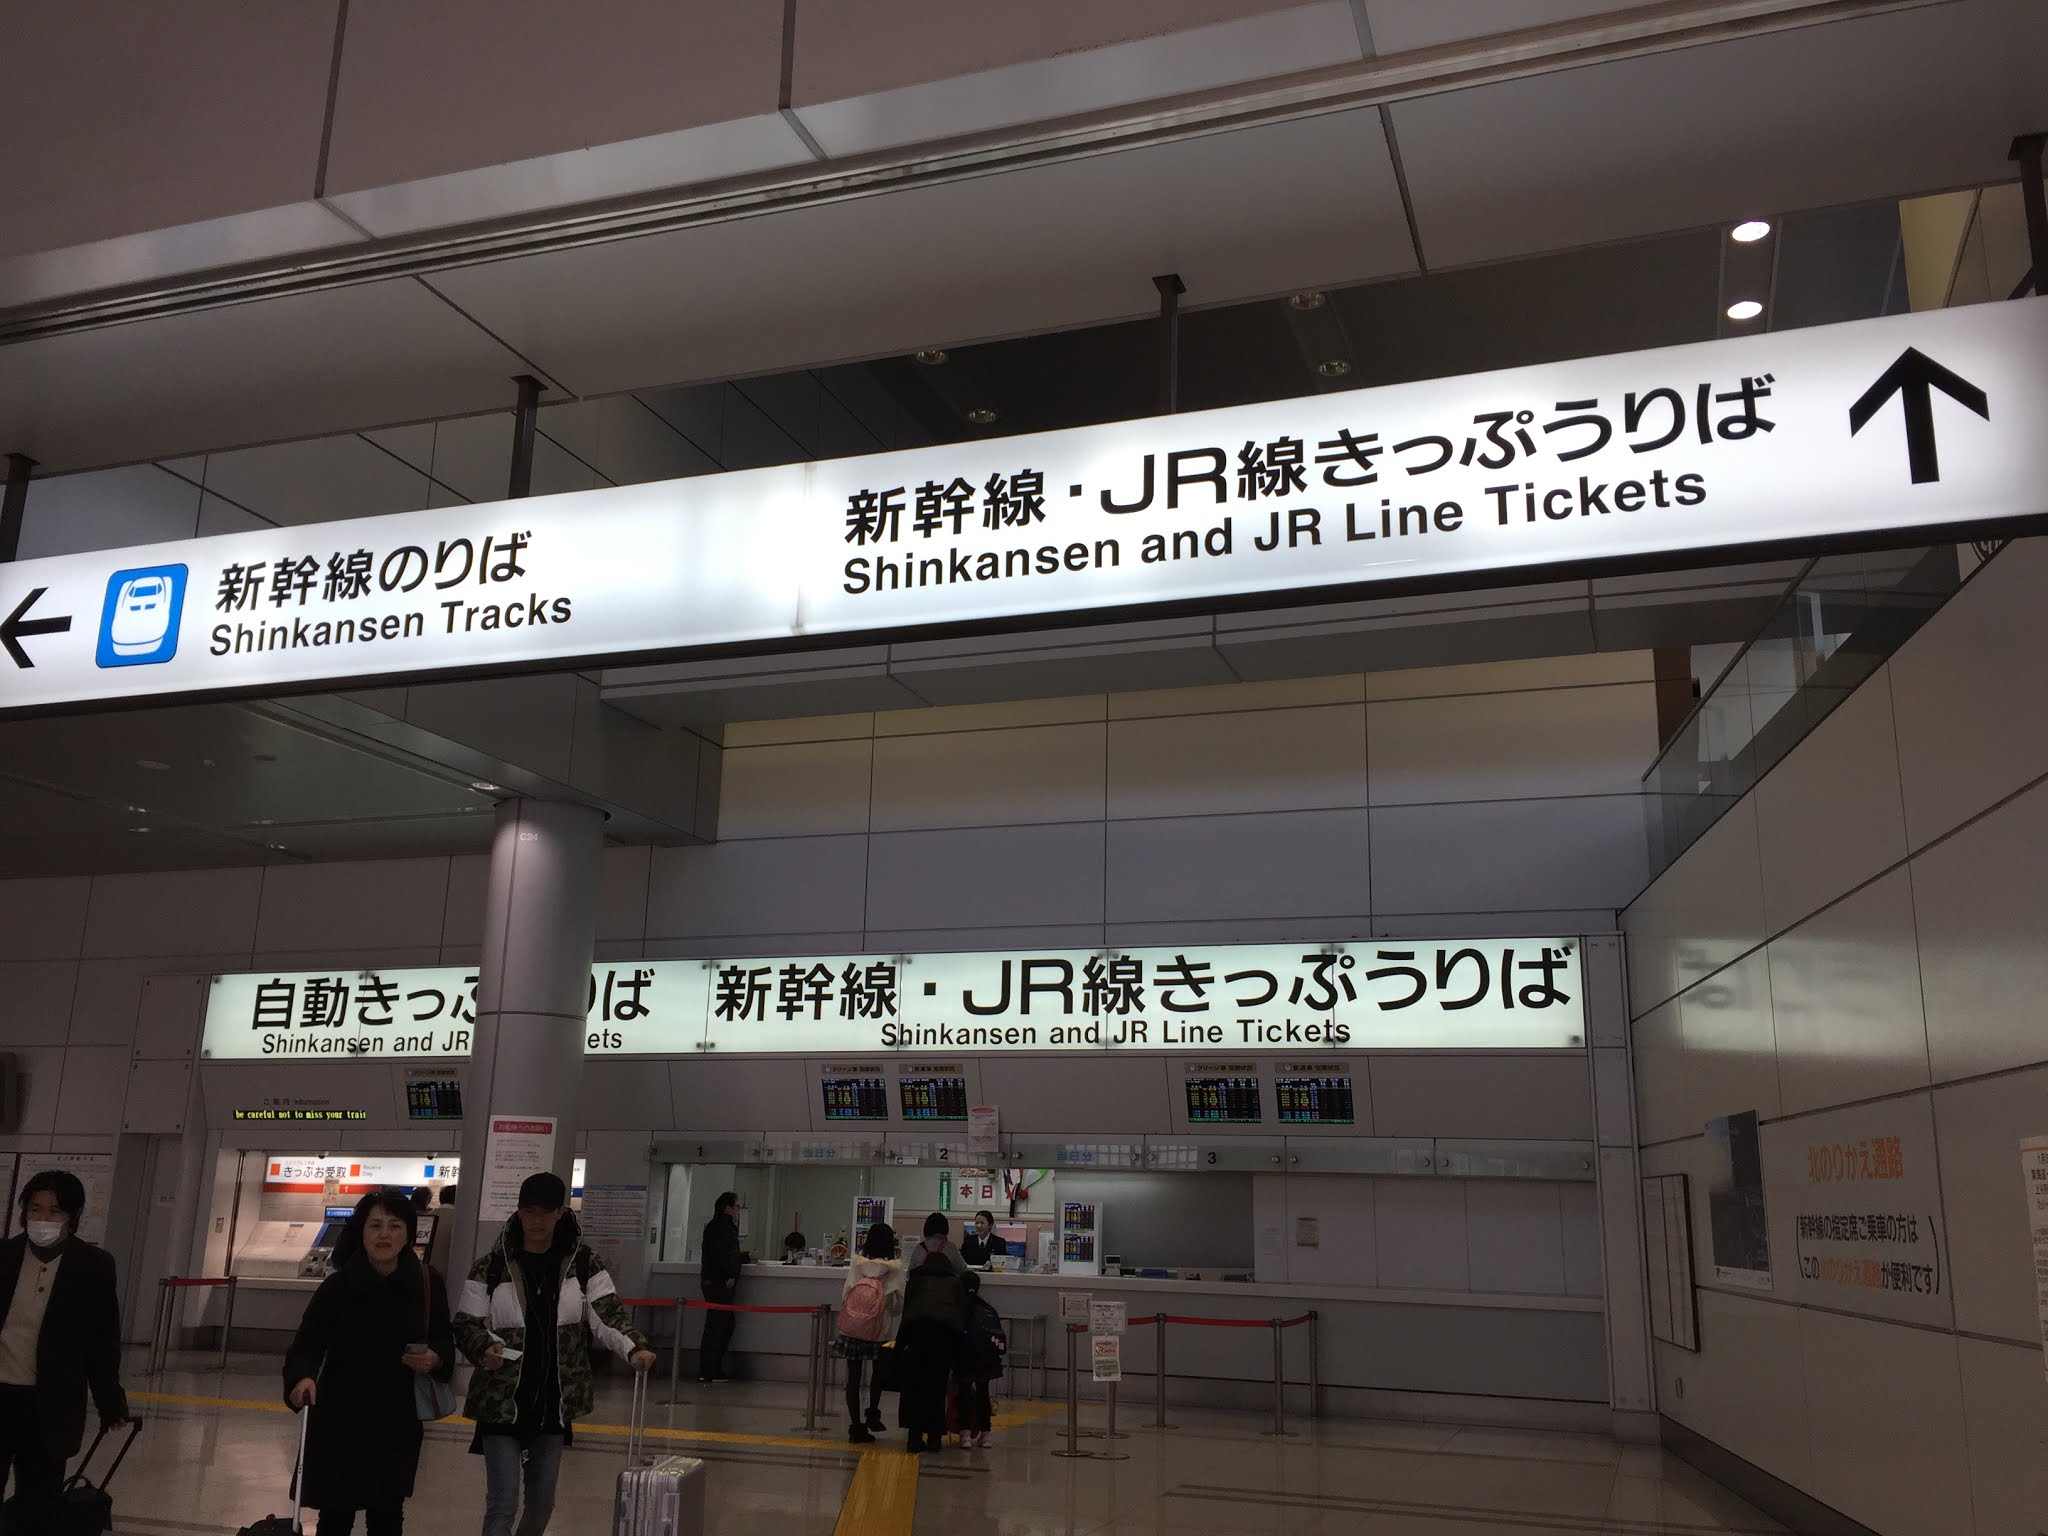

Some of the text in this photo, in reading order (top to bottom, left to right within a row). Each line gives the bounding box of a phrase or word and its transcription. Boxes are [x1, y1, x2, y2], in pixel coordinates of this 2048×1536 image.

[844, 374, 1776, 546] 新幹線・JR線きっぷうりば
[844, 470, 1707, 595] Shinkansen and JR Line Tickets
[216, 531, 532, 613] 新幹線のりば
[210, 593, 572, 656] Shinkansen Tracks
[715, 947, 1571, 1022] 新幹線・JR線きっぷうりば
[262, 1030, 470, 1054] Shinkansen and JR
[881, 1018, 1351, 1049] Shinkansen and JR Line Tickets
[247, 1110, 275, 1119] careful
[278, 1110, 291, 1119] not
[294, 1110, 303, 1119] to
[326, 1111, 343, 1120] your
[697, 1146, 703, 1158] 1
[939, 1148, 948, 1160] 2
[1207, 1152, 1216, 1164] 3
